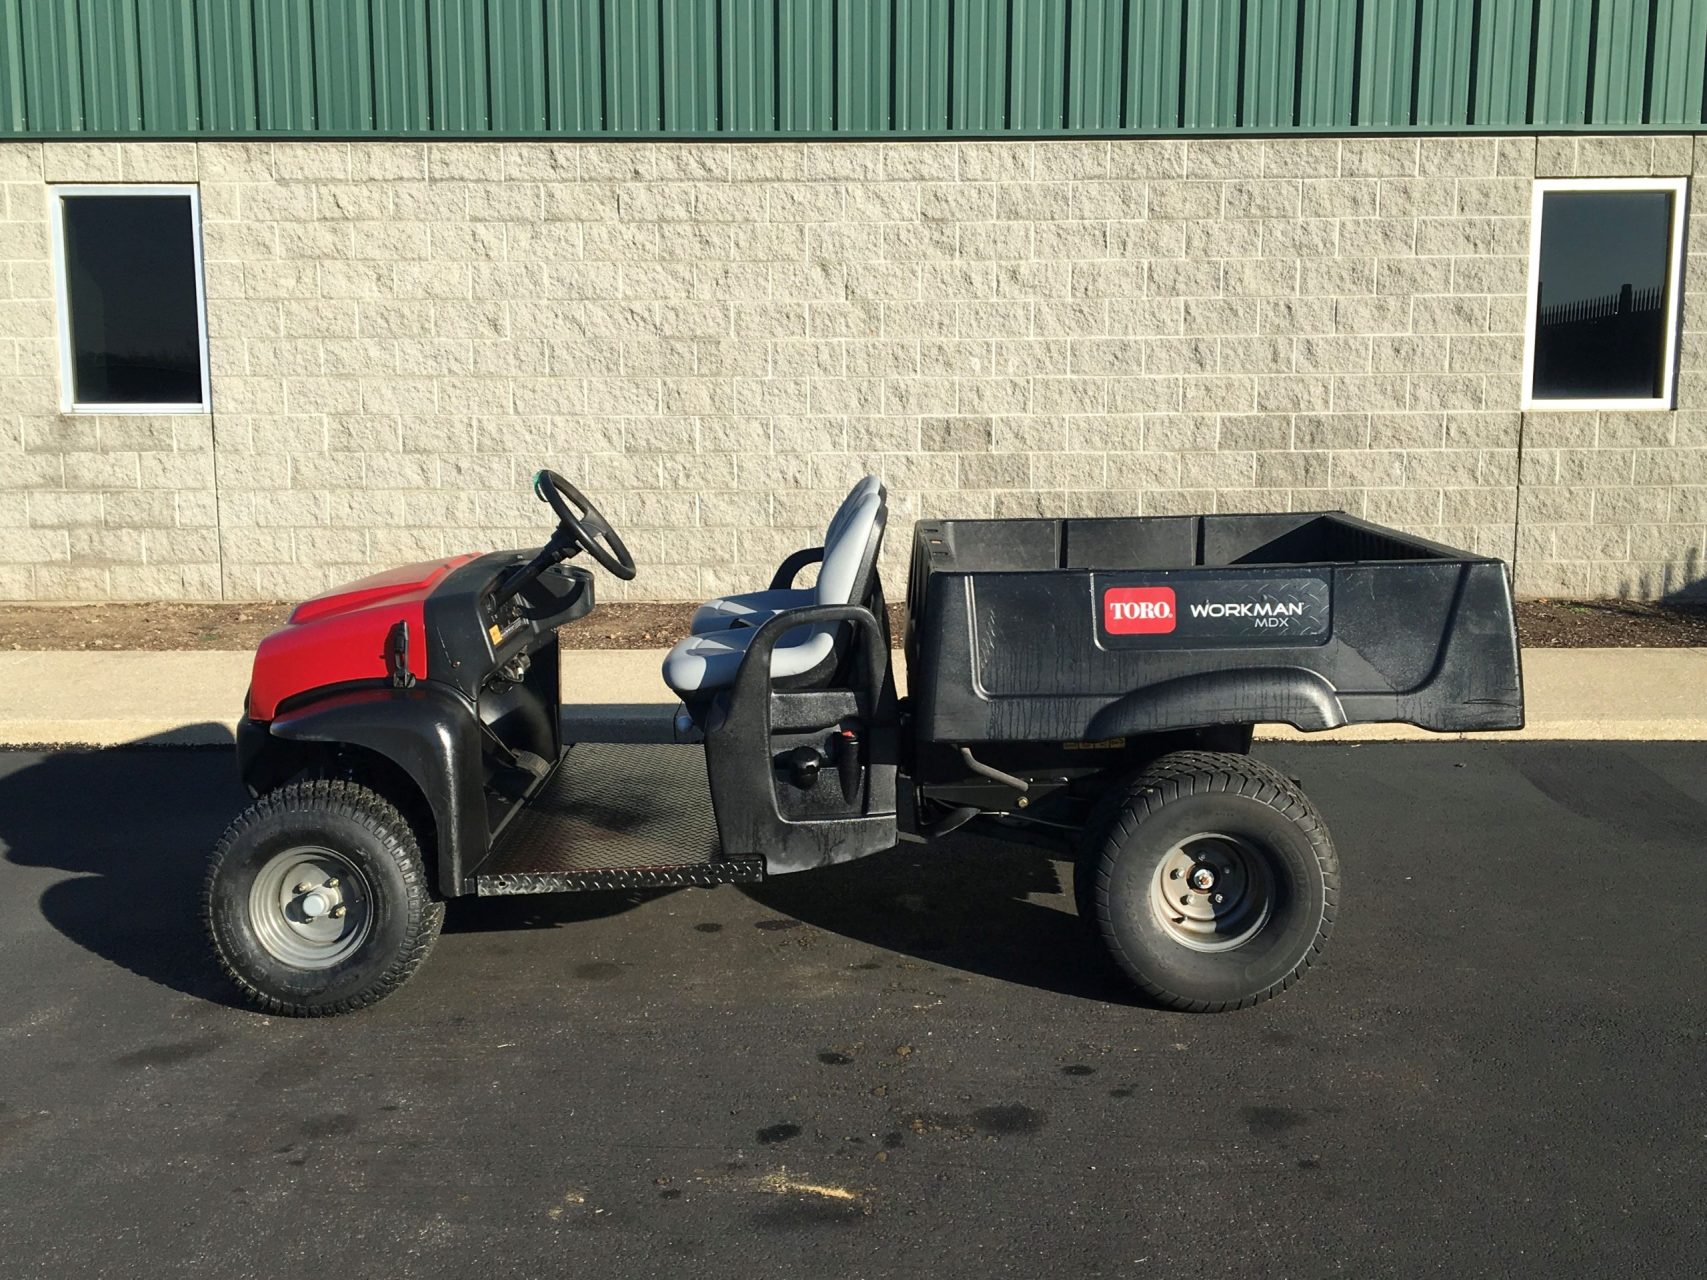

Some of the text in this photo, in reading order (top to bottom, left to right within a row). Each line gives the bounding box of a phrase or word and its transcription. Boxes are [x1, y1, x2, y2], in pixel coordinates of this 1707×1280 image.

[1110, 601, 1172, 620] TORO
[1190, 602, 1304, 618] WORKMAN
[1254, 617, 1289, 628] MDX
